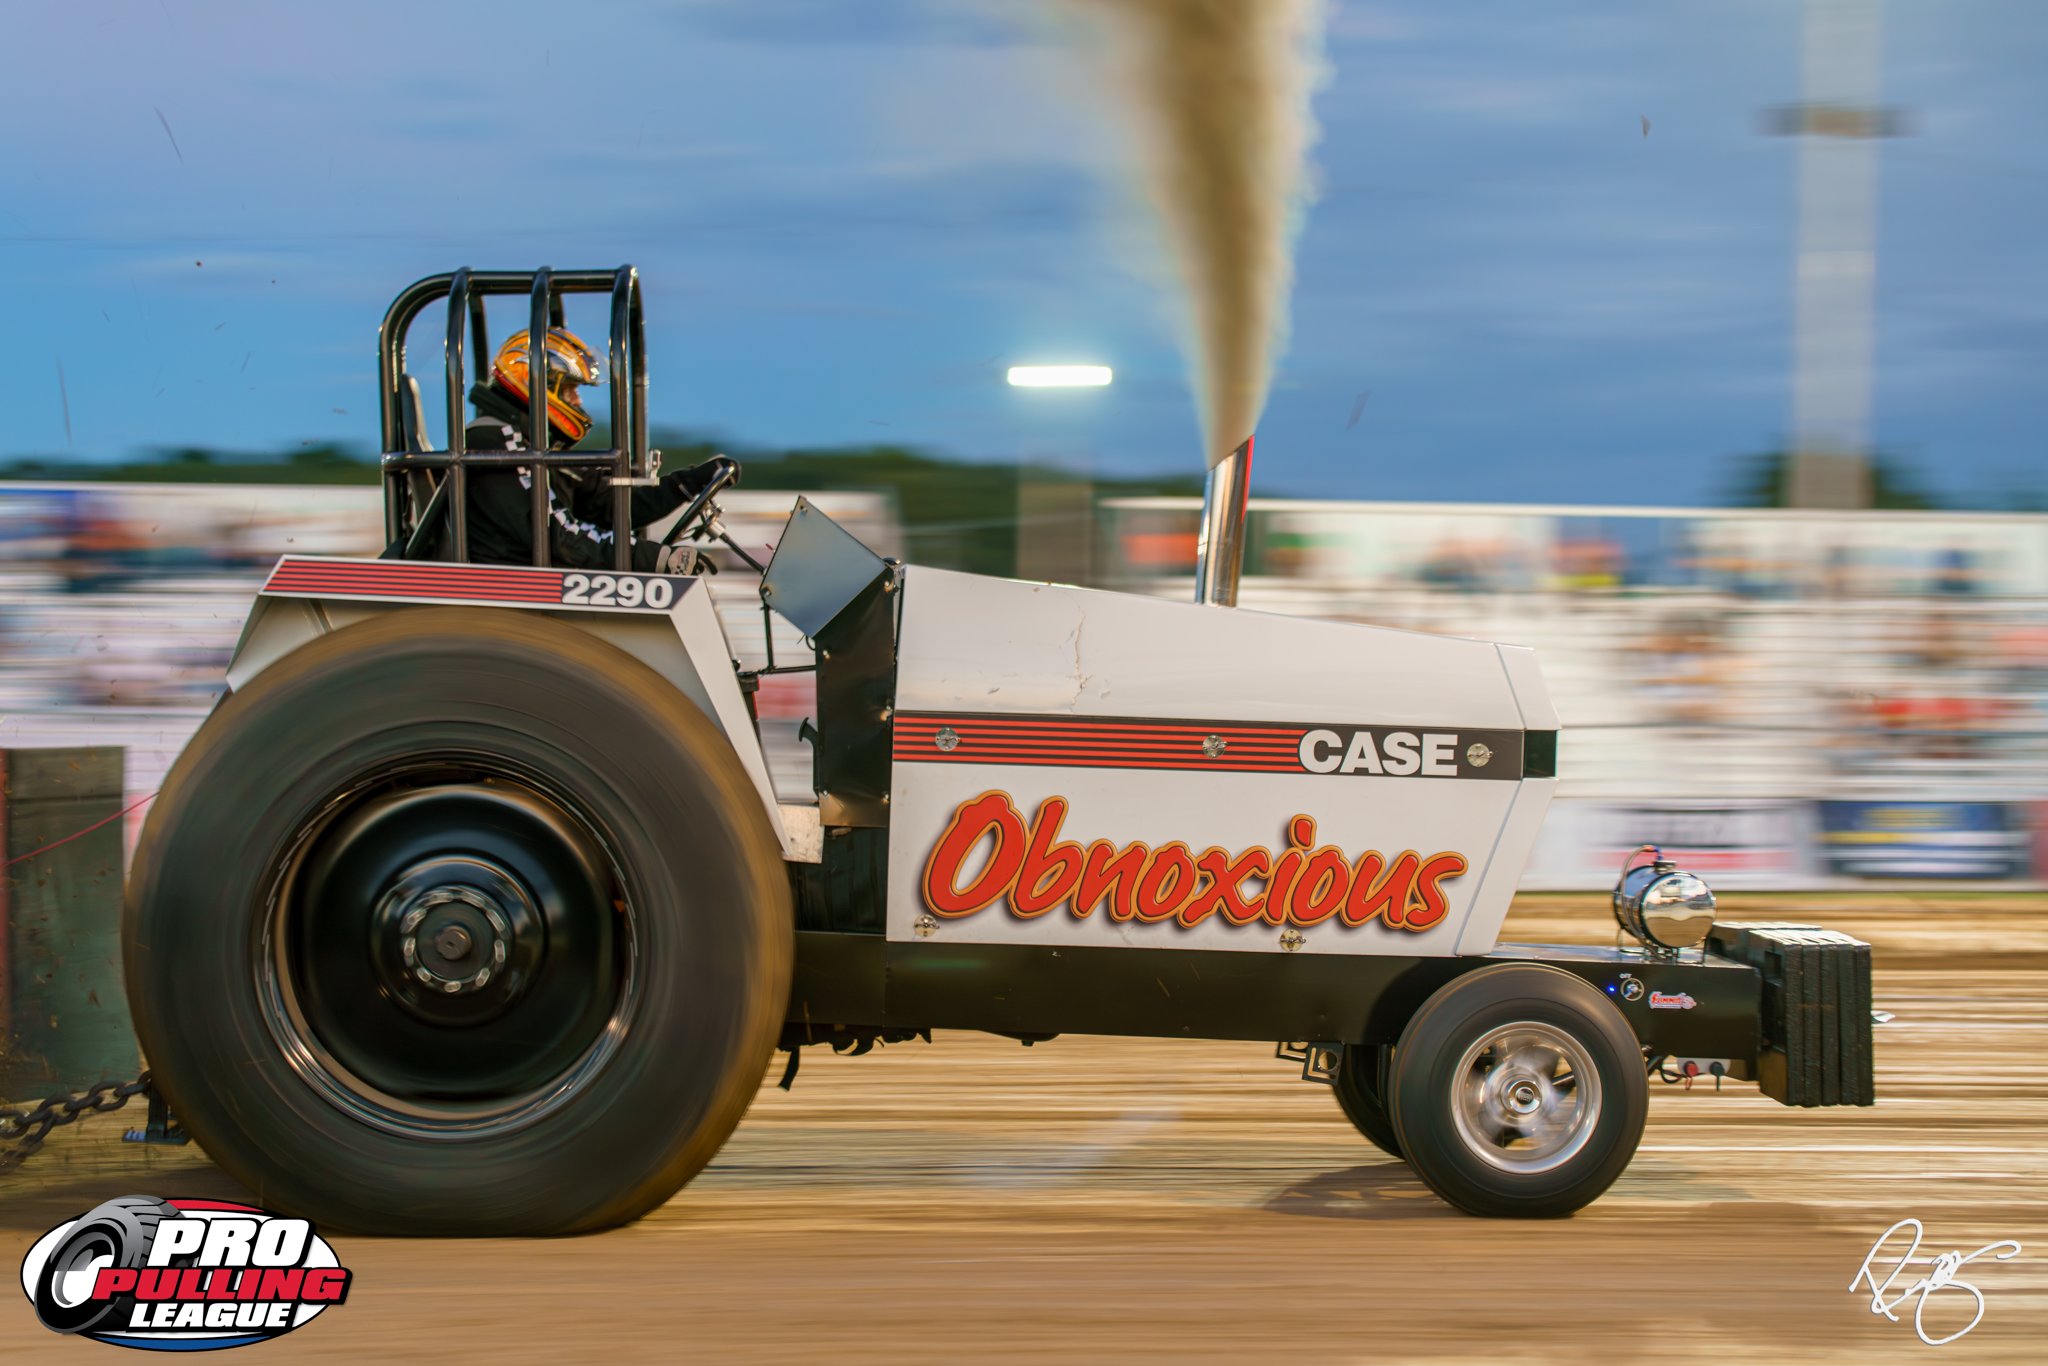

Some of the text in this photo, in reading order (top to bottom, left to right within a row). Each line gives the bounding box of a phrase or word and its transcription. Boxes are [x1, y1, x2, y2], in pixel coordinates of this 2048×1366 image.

[562, 573, 673, 609] 2290
[1299, 729, 1458, 776] CASE
[922, 789, 1468, 933] Obnoxious
